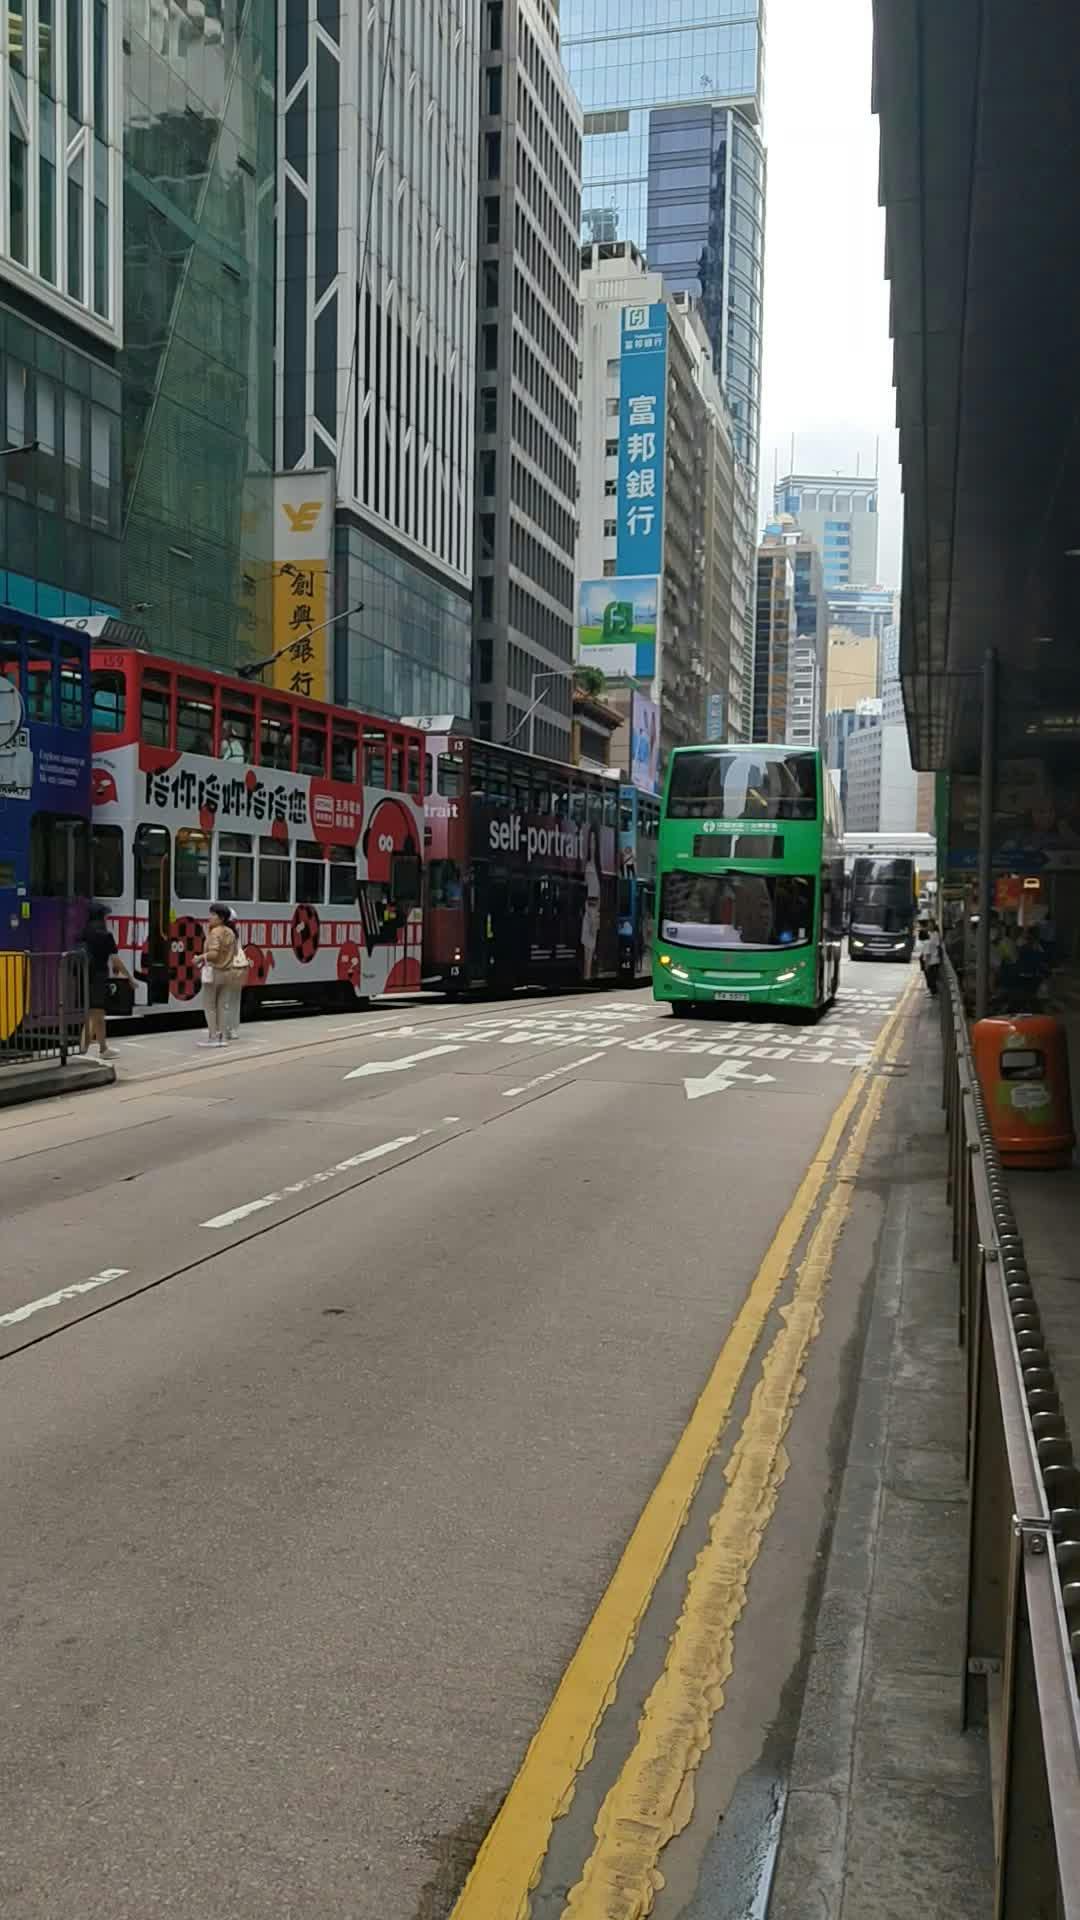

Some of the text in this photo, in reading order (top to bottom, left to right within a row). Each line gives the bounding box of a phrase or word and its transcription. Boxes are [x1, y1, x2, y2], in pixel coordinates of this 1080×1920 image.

[625, 395, 657, 537] 富邦銀行
[289, 570, 316, 697] 創興銀行
[416, 718, 433, 729] 13
[488, 814, 586, 863] self-portrait
[624, 1036, 878, 1067] PEDDER
